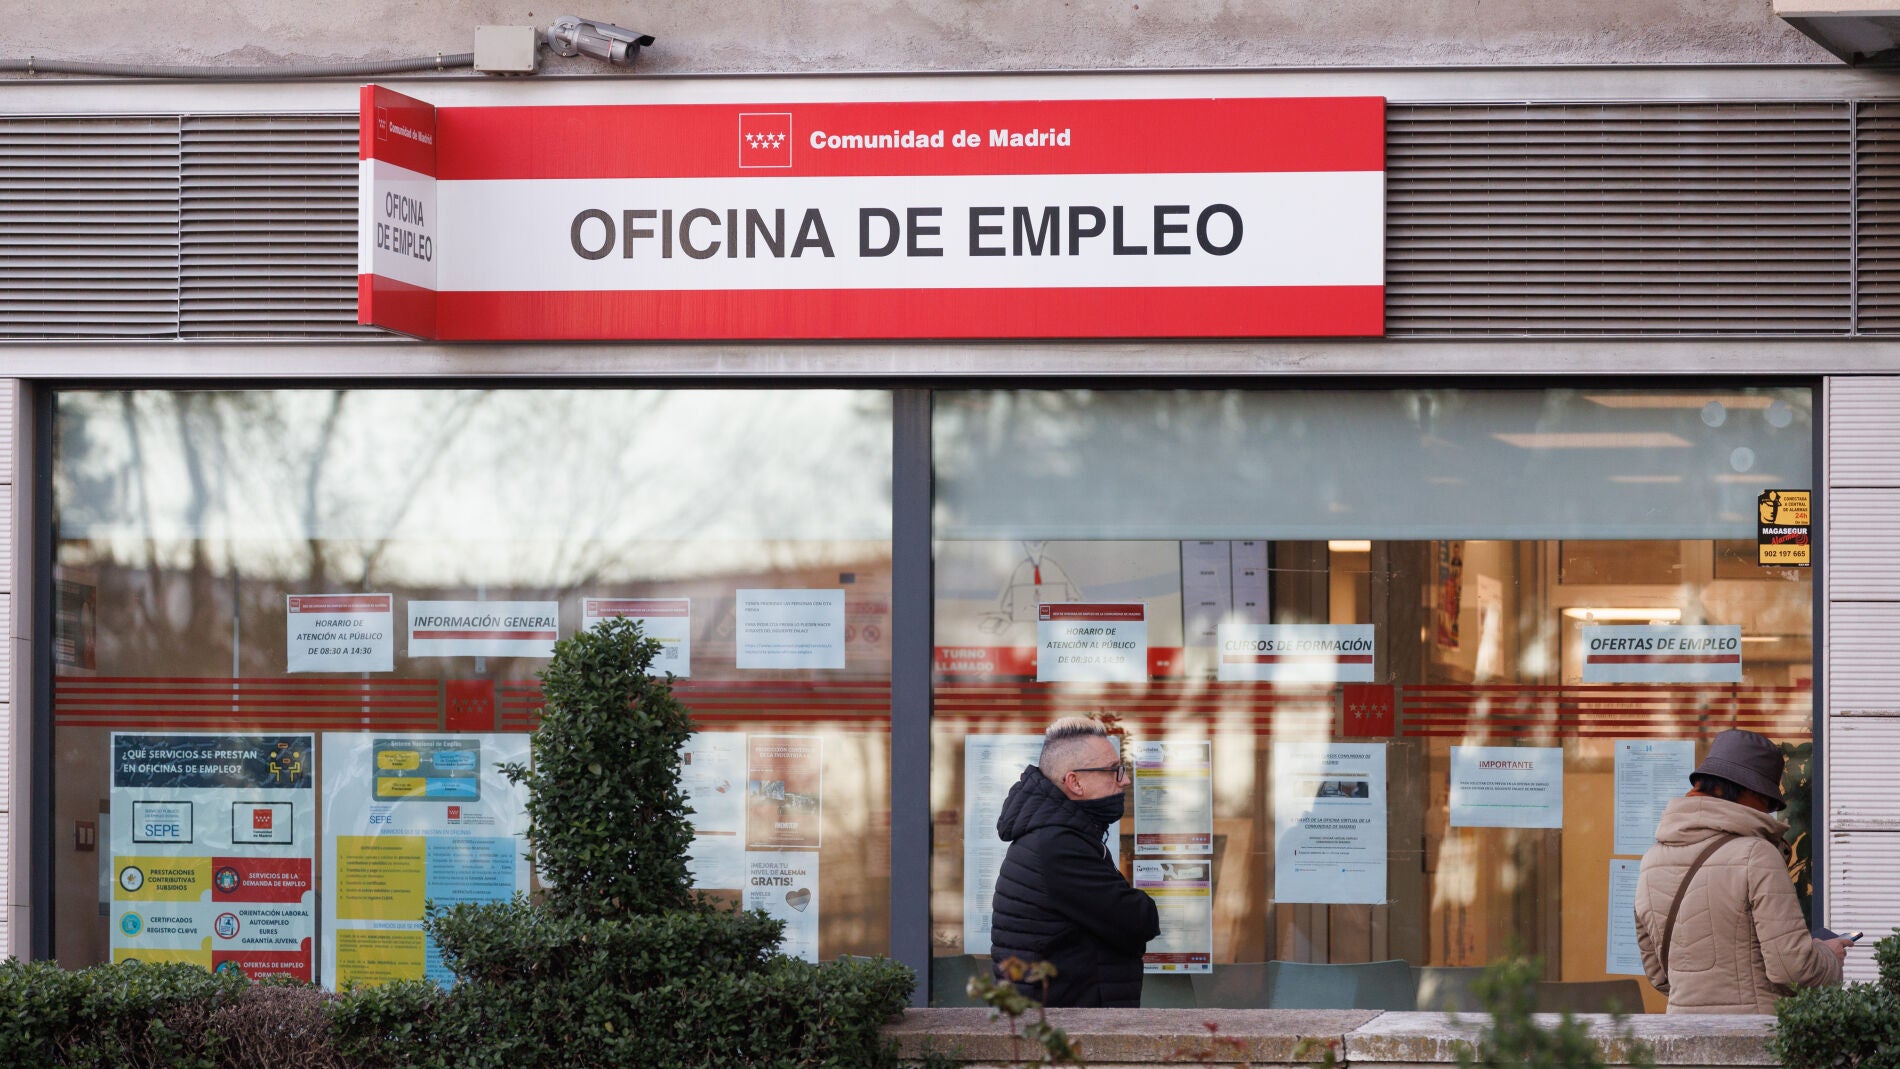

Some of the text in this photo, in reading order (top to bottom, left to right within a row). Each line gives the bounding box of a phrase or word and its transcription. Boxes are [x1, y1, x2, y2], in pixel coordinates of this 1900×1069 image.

[809, 128, 1072, 150] Comunidad de Madrid
[385, 191, 425, 227] OFICINA
[570, 203, 1245, 260] OFICINA DE EMPLEO
[377, 222, 433, 263] DE EMPLEO
[414, 614, 557, 628] INFORMACIÓN GENERAL
[296, 631, 336, 641] ATENCIÓN
[349, 632, 383, 640] PÚBLICO
[1046, 640, 1088, 649] ATENCIÓN
[1101, 640, 1136, 648] PÚBLICO
[1225, 637, 1372, 651] CURSOS DE FORMACIÓN
[1590, 637, 1737, 651] OFERTAS DE EMPLEO
[308, 647, 372, 655] DE 08:30 A 14:30
[942, 648, 986, 659] TURNO
[935, 661, 994, 672] LLAMADO
[122, 749, 257, 760] ¿QUÉ SERVICIOS SE PRESTAN
[123, 764, 242, 774] EN OFICINAS DE EMPLEO?
[1479, 760, 1534, 769] IMPORTANTE
[369, 815, 393, 824] SEPE
[145, 824, 180, 837] SEPE
[751, 877, 793, 887] GRATIS!
[239, 909, 280, 917] ORIENTACIÓN
[150, 916, 193, 924] CERTIFICADOS
[177, 927, 198, 935] CL@VE
